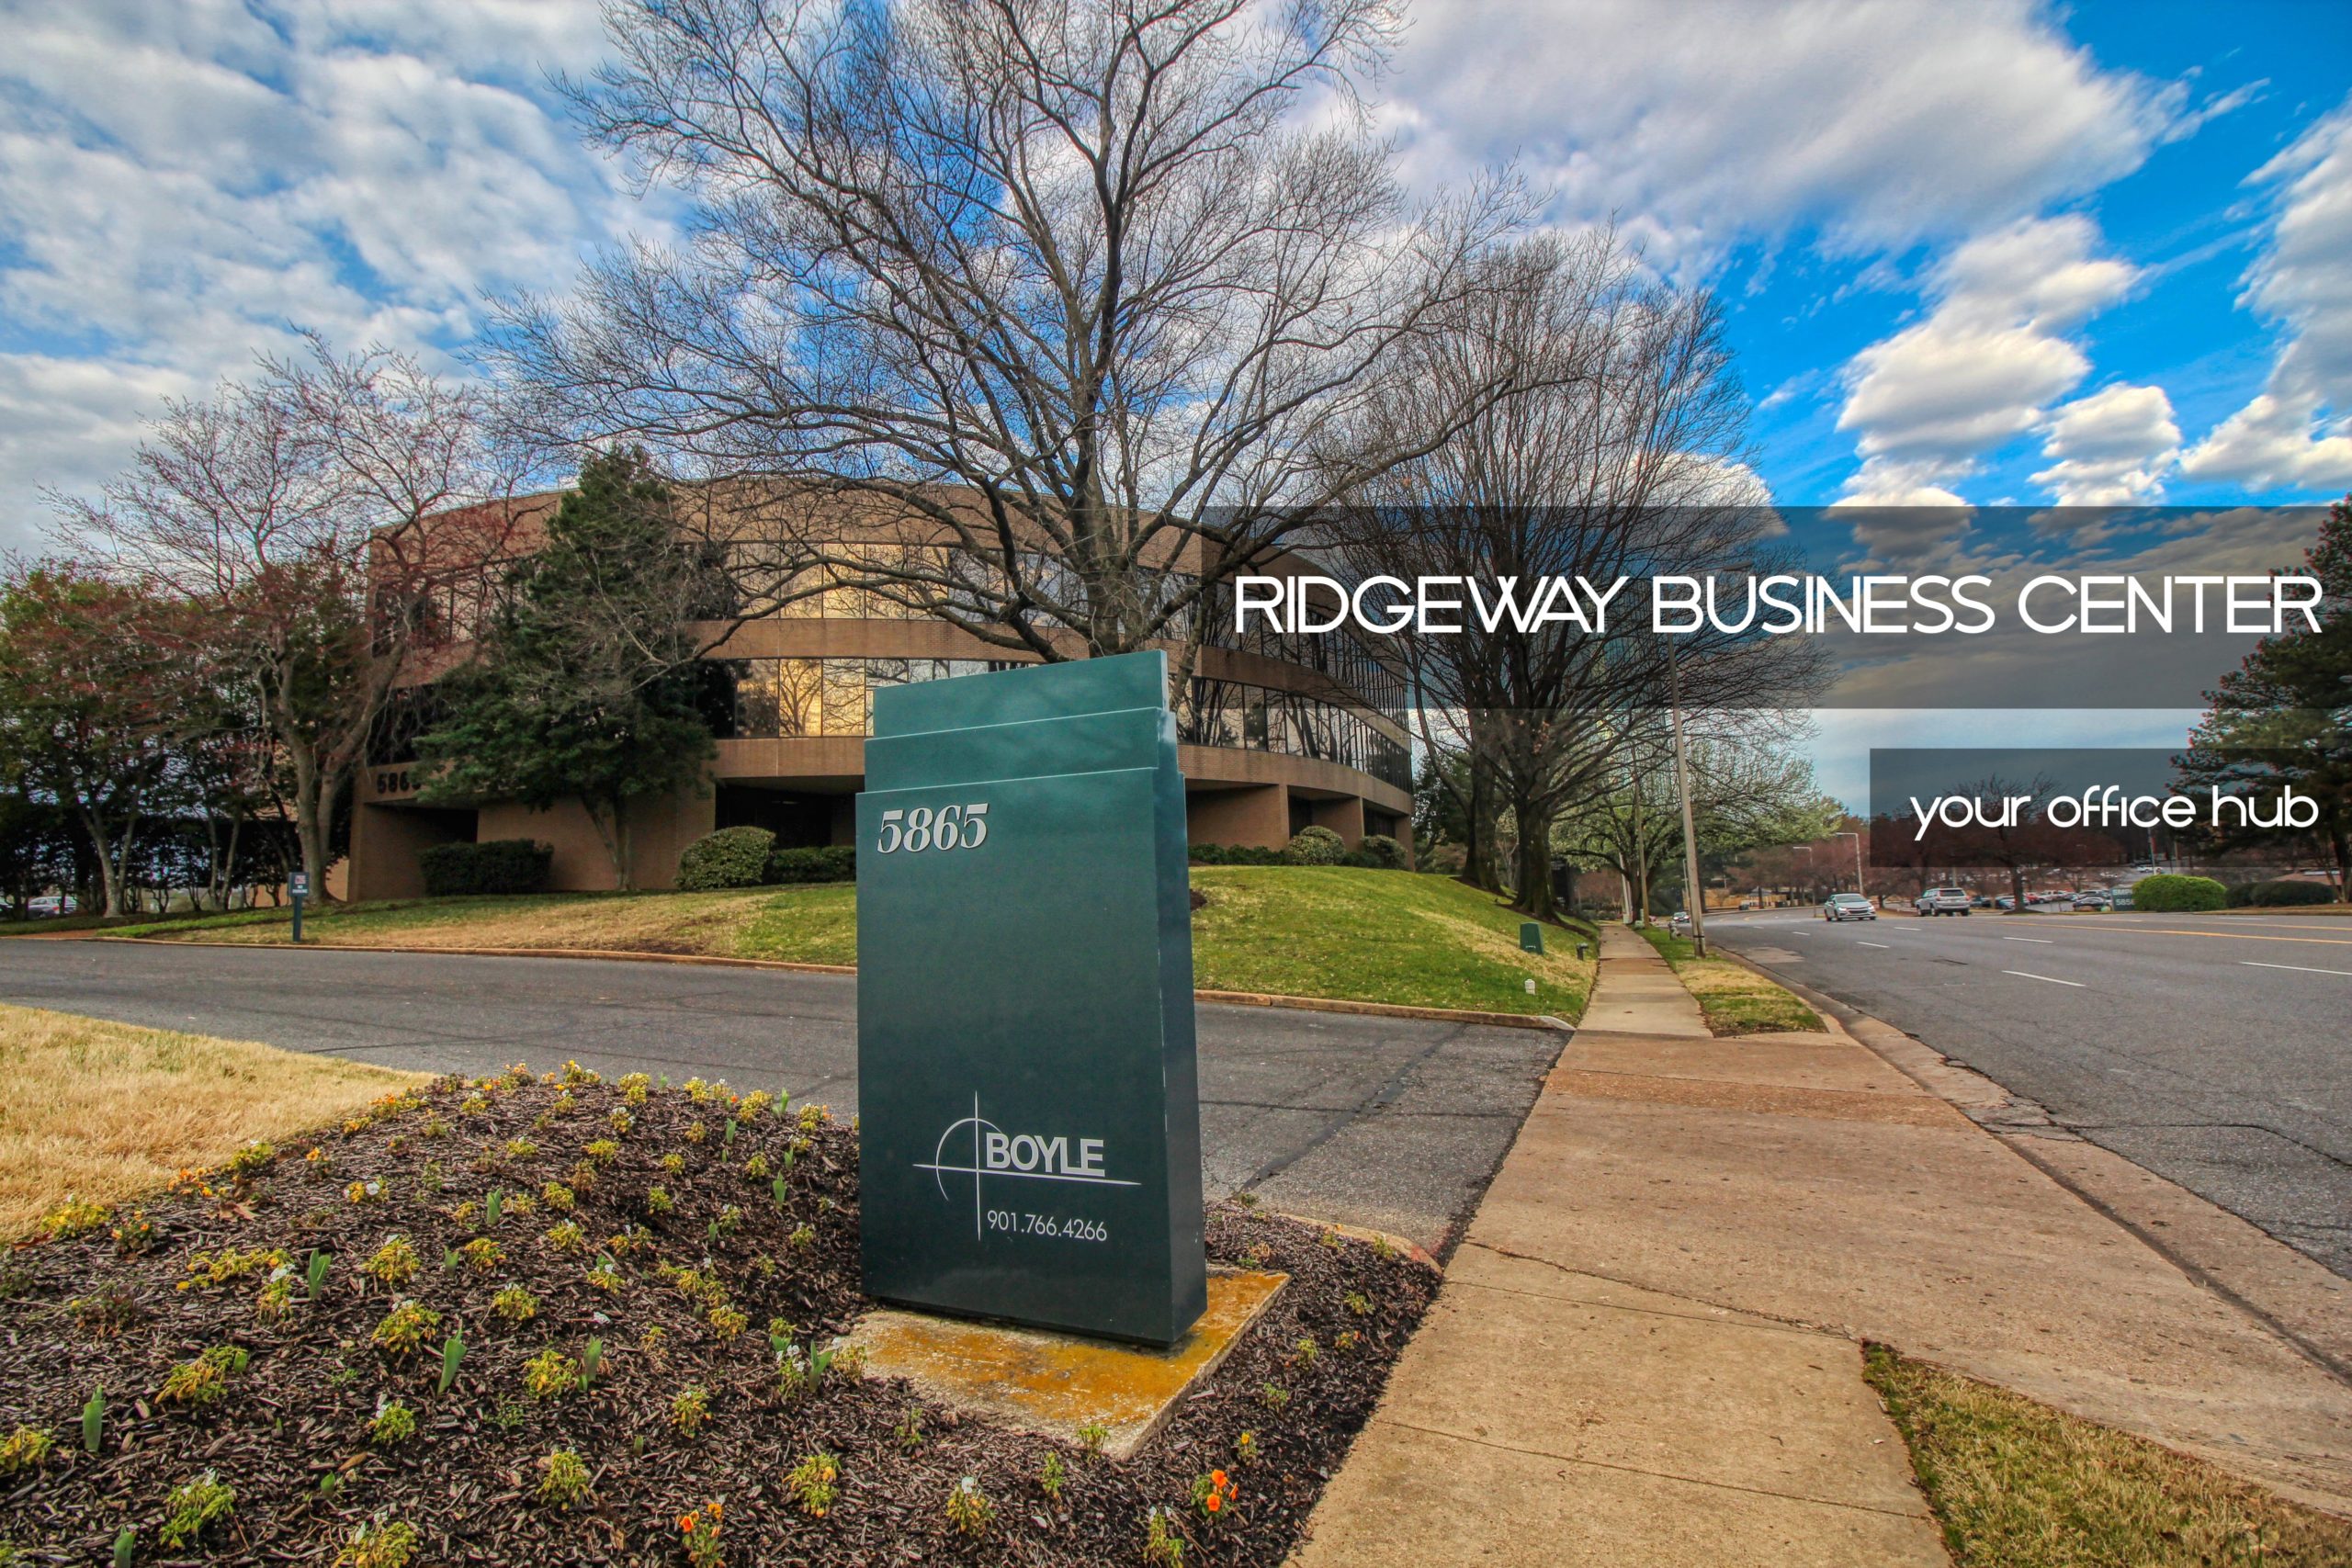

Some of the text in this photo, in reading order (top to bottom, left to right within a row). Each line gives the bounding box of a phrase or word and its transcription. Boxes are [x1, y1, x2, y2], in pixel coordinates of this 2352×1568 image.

[876, 803, 989, 854] 5865
[986, 1132, 1106, 1178] BOYLE
[987, 1210, 1108, 1242] 901.766.4266
